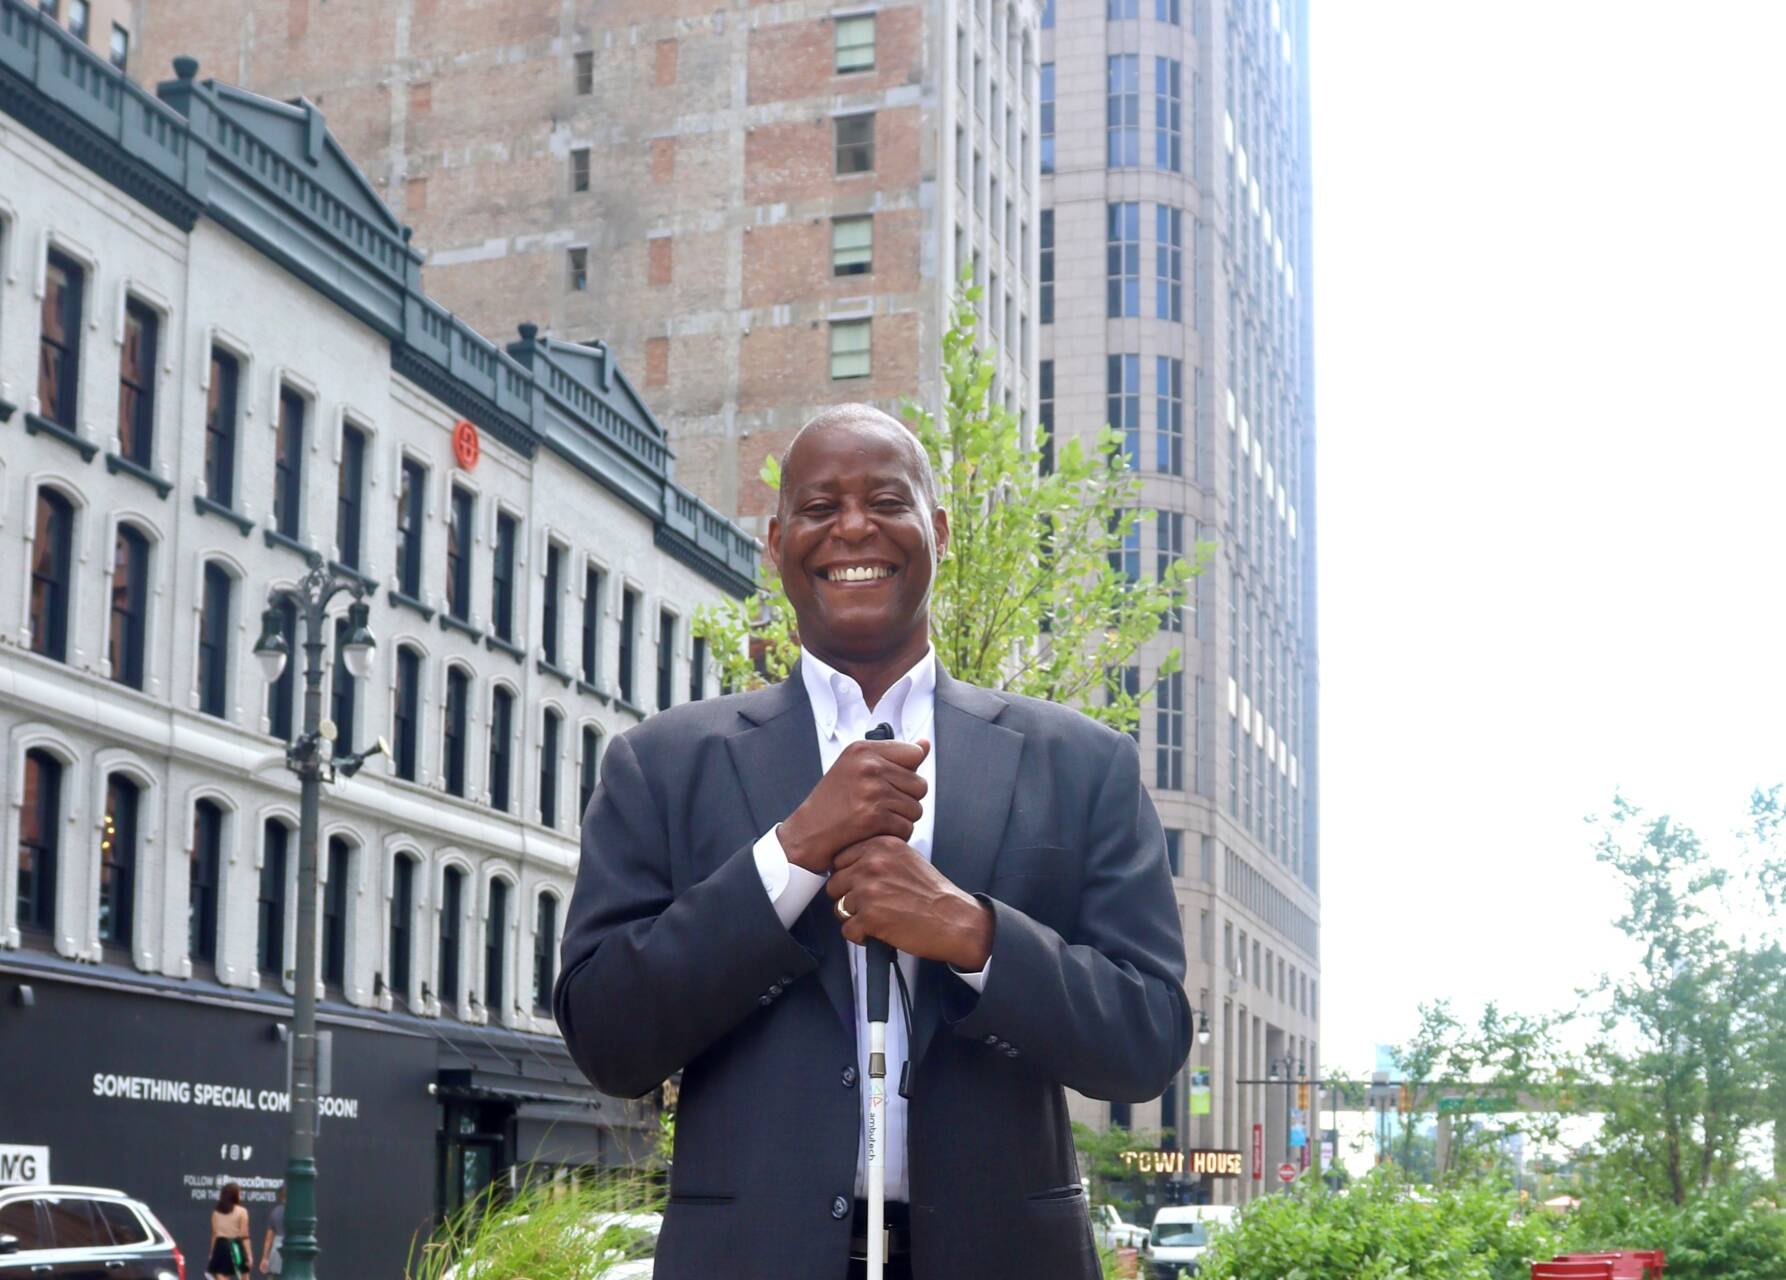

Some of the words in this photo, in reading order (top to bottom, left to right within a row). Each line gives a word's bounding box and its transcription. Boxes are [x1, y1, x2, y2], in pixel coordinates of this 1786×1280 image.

[93, 1073, 190, 1103] SOMETHING
[193, 1083, 255, 1109] SPECIAL
[258, 1090, 292, 1112] COM
[1194, 1153, 1242, 1174] HOUSE
[183, 1174, 214, 1186] FOLLOW
[191, 1189, 207, 1200] FOR
